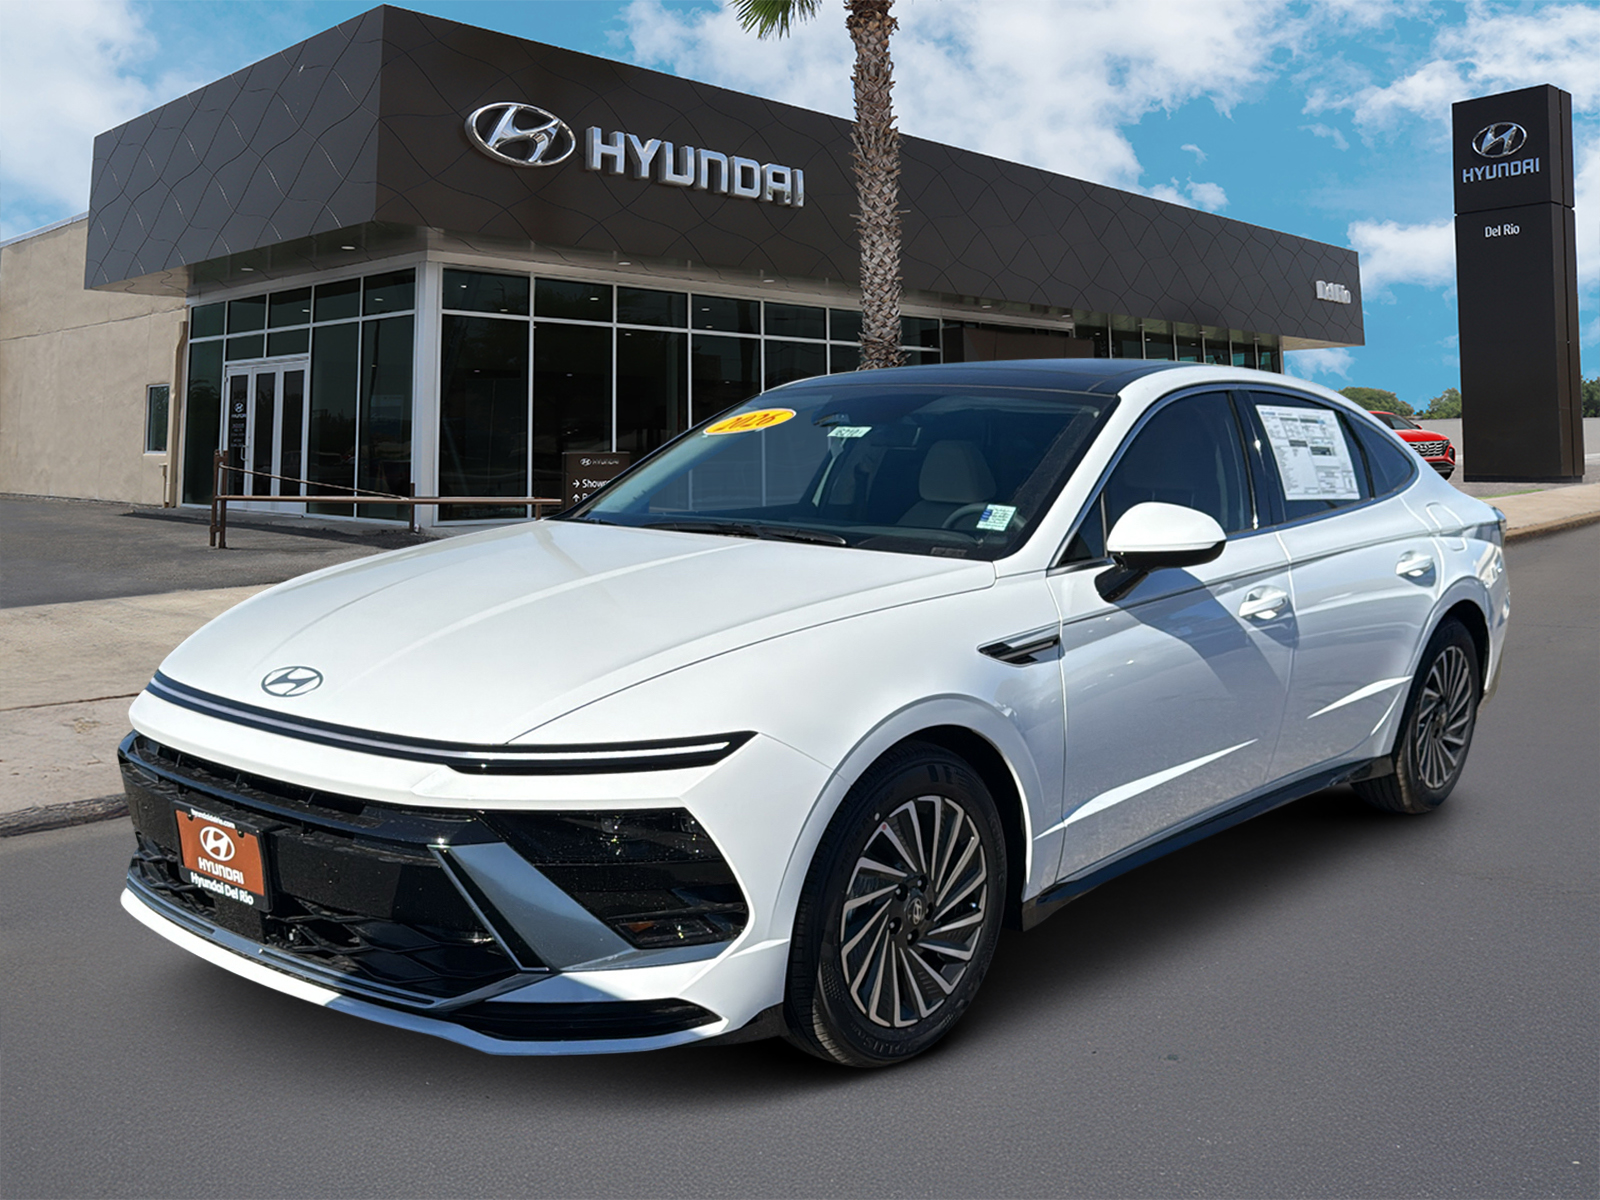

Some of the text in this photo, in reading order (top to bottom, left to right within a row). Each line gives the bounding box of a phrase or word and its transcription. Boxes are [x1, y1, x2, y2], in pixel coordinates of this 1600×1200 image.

[586, 125, 805, 207] HYUNDAI
[1462, 157, 1540, 183] HYUNDAI
[1484, 223, 1520, 238] Del Rio
[198, 856, 245, 885] HYUNDAI
[190, 871, 254, 906] Hyundai Del Rio
